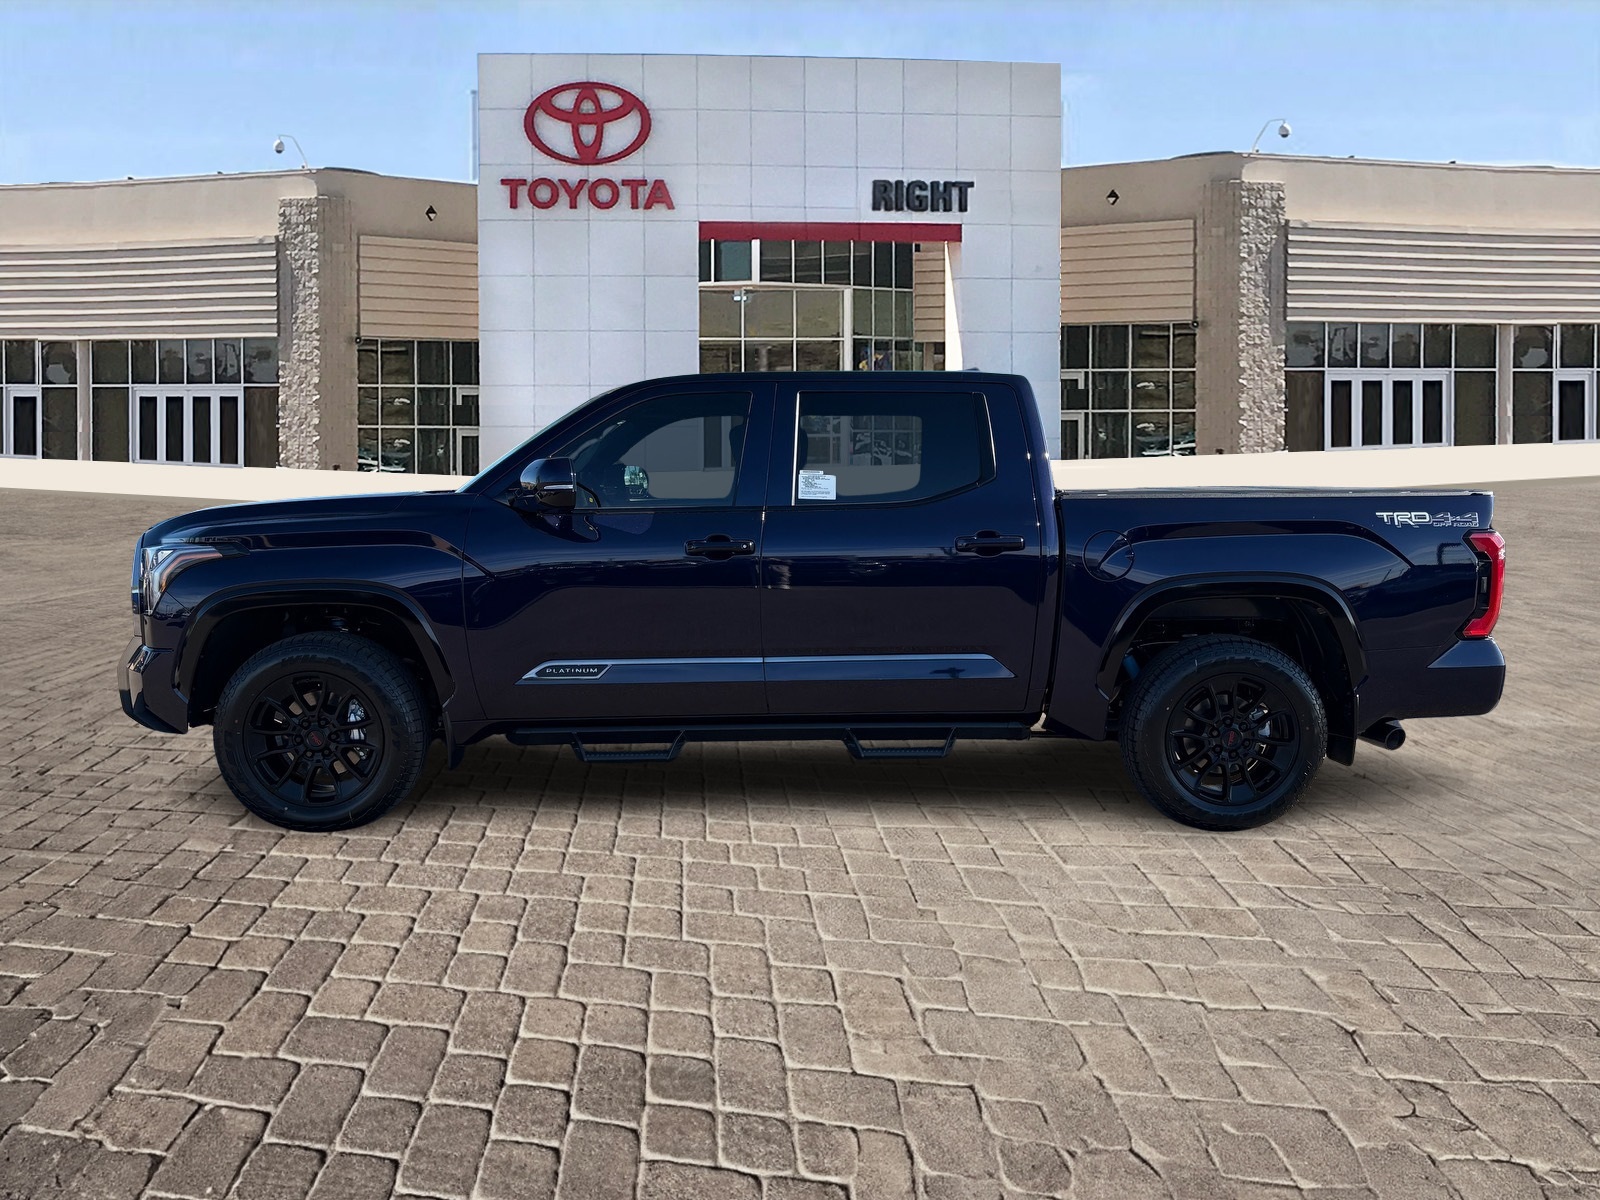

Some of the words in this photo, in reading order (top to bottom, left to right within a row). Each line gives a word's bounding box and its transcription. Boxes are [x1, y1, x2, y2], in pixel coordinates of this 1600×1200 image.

[500, 178, 675, 210] TOYOTA
[871, 179, 975, 213] RIGHT
[1375, 511, 1432, 527] TRD
